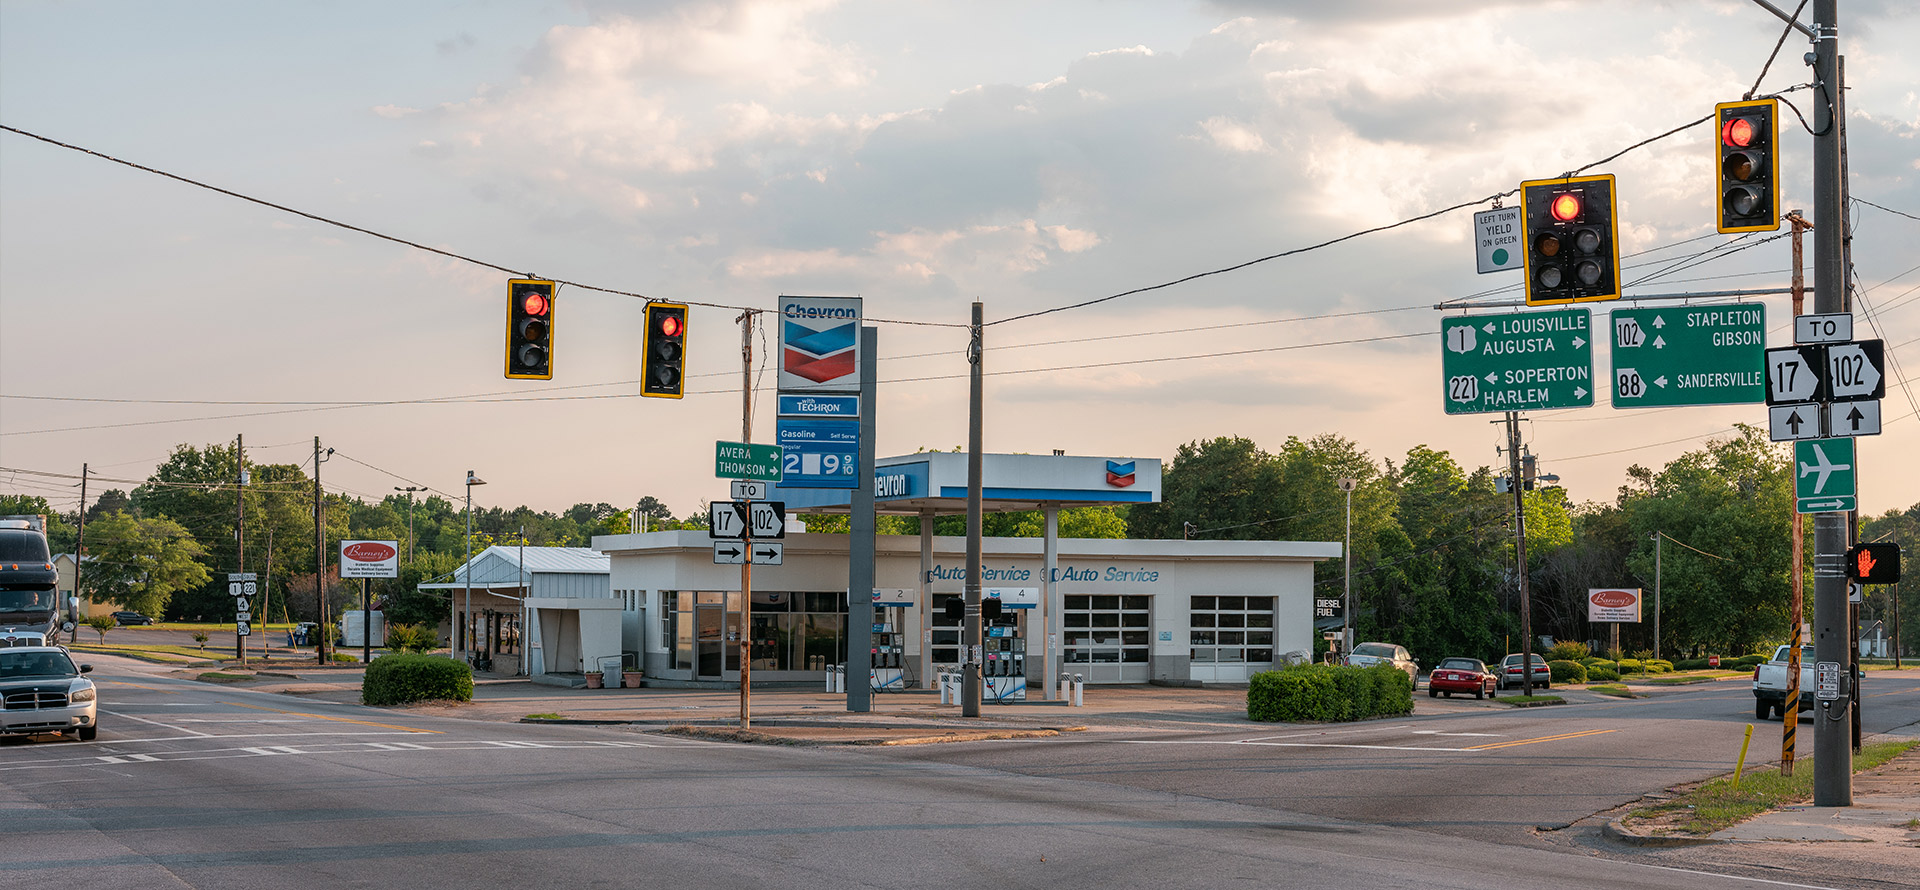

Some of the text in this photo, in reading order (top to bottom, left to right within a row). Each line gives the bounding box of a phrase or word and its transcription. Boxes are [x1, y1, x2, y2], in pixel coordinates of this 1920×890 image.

[1480, 212, 1516, 224] LEFT TURN
[1486, 224, 1512, 236] YIELD
[1482, 236, 1517, 247] ON GREEN
[784, 303, 856, 320] Chevron
[1687, 310, 1761, 327] STAPLETON
[1503, 316, 1586, 334] LOUISVILLE
[1810, 320, 1836, 336] TO
[1459, 328, 1465, 351] 1
[1618, 323, 1638, 345] 102
[1713, 331, 1761, 346] GIBSON
[1483, 338, 1555, 355] AUGUSTA
[1505, 366, 1588, 384] SOPERTON
[1777, 361, 1799, 393] 17
[1833, 354, 1864, 387] 102
[1619, 374, 1640, 397] 88
[1677, 372, 1762, 388] SANDERSVILLE
[1451, 377, 1476, 400] 221
[1484, 389, 1549, 405] HARLEM
[797, 402, 840, 413] TECHRON
[781, 430, 816, 438] Gasoline
[719, 447, 752, 460] AVERA
[844, 454, 852, 464] 9
[719, 461, 766, 475] THOMSON
[784, 453, 839, 474] 2 9
[740, 485, 756, 496] TO
[717, 511, 733, 530] 17
[754, 510, 773, 530] 102
[932, 564, 966, 580] Auto
[1061, 567, 1098, 582] Auto
[1103, 566, 1159, 582] Service
[245, 584, 255, 593] 221
[897, 590, 904, 598] 2
[1019, 589, 1025, 598] 4
[239, 601, 245, 609] 4
[1316, 599, 1341, 608] DIESEL
[1316, 608, 1335, 616] FUEL
